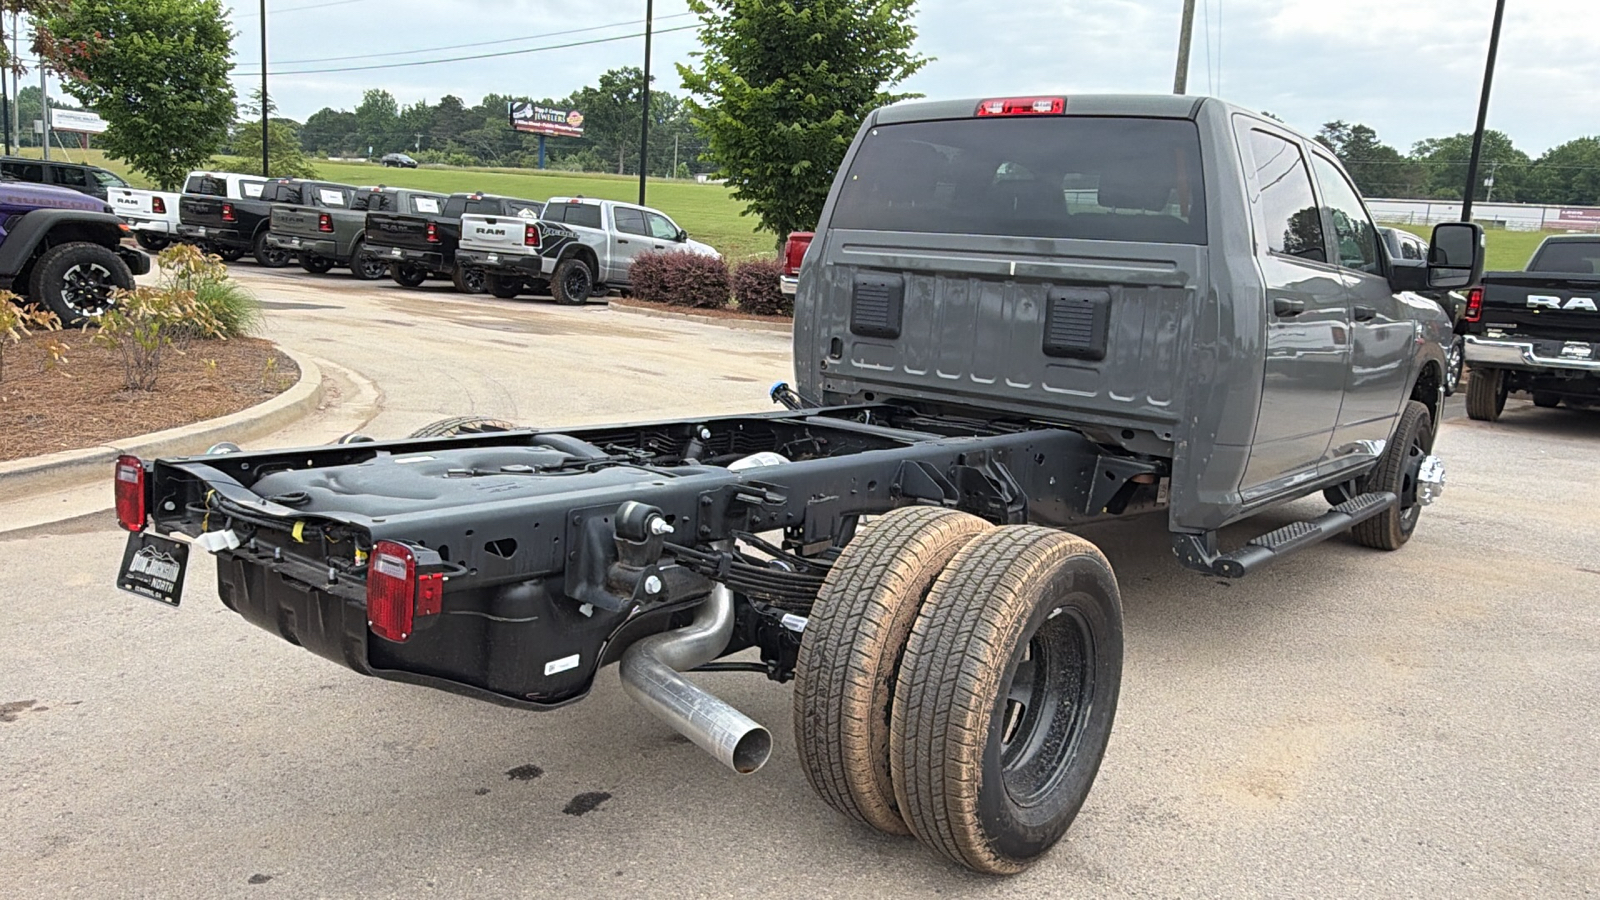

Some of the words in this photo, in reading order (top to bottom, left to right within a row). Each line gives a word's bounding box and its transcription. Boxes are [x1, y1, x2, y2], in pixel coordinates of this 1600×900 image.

[534, 112, 566, 123] JEWELERS
[7, 195, 98, 210] RUBICON
[187, 205, 209, 213] RAM
[379, 223, 408, 232] RAM
[475, 227, 506, 236] RAM
[129, 552, 149, 573] DON
[144, 557, 180, 583] JACKSON
[150, 577, 175, 594] NORTH
